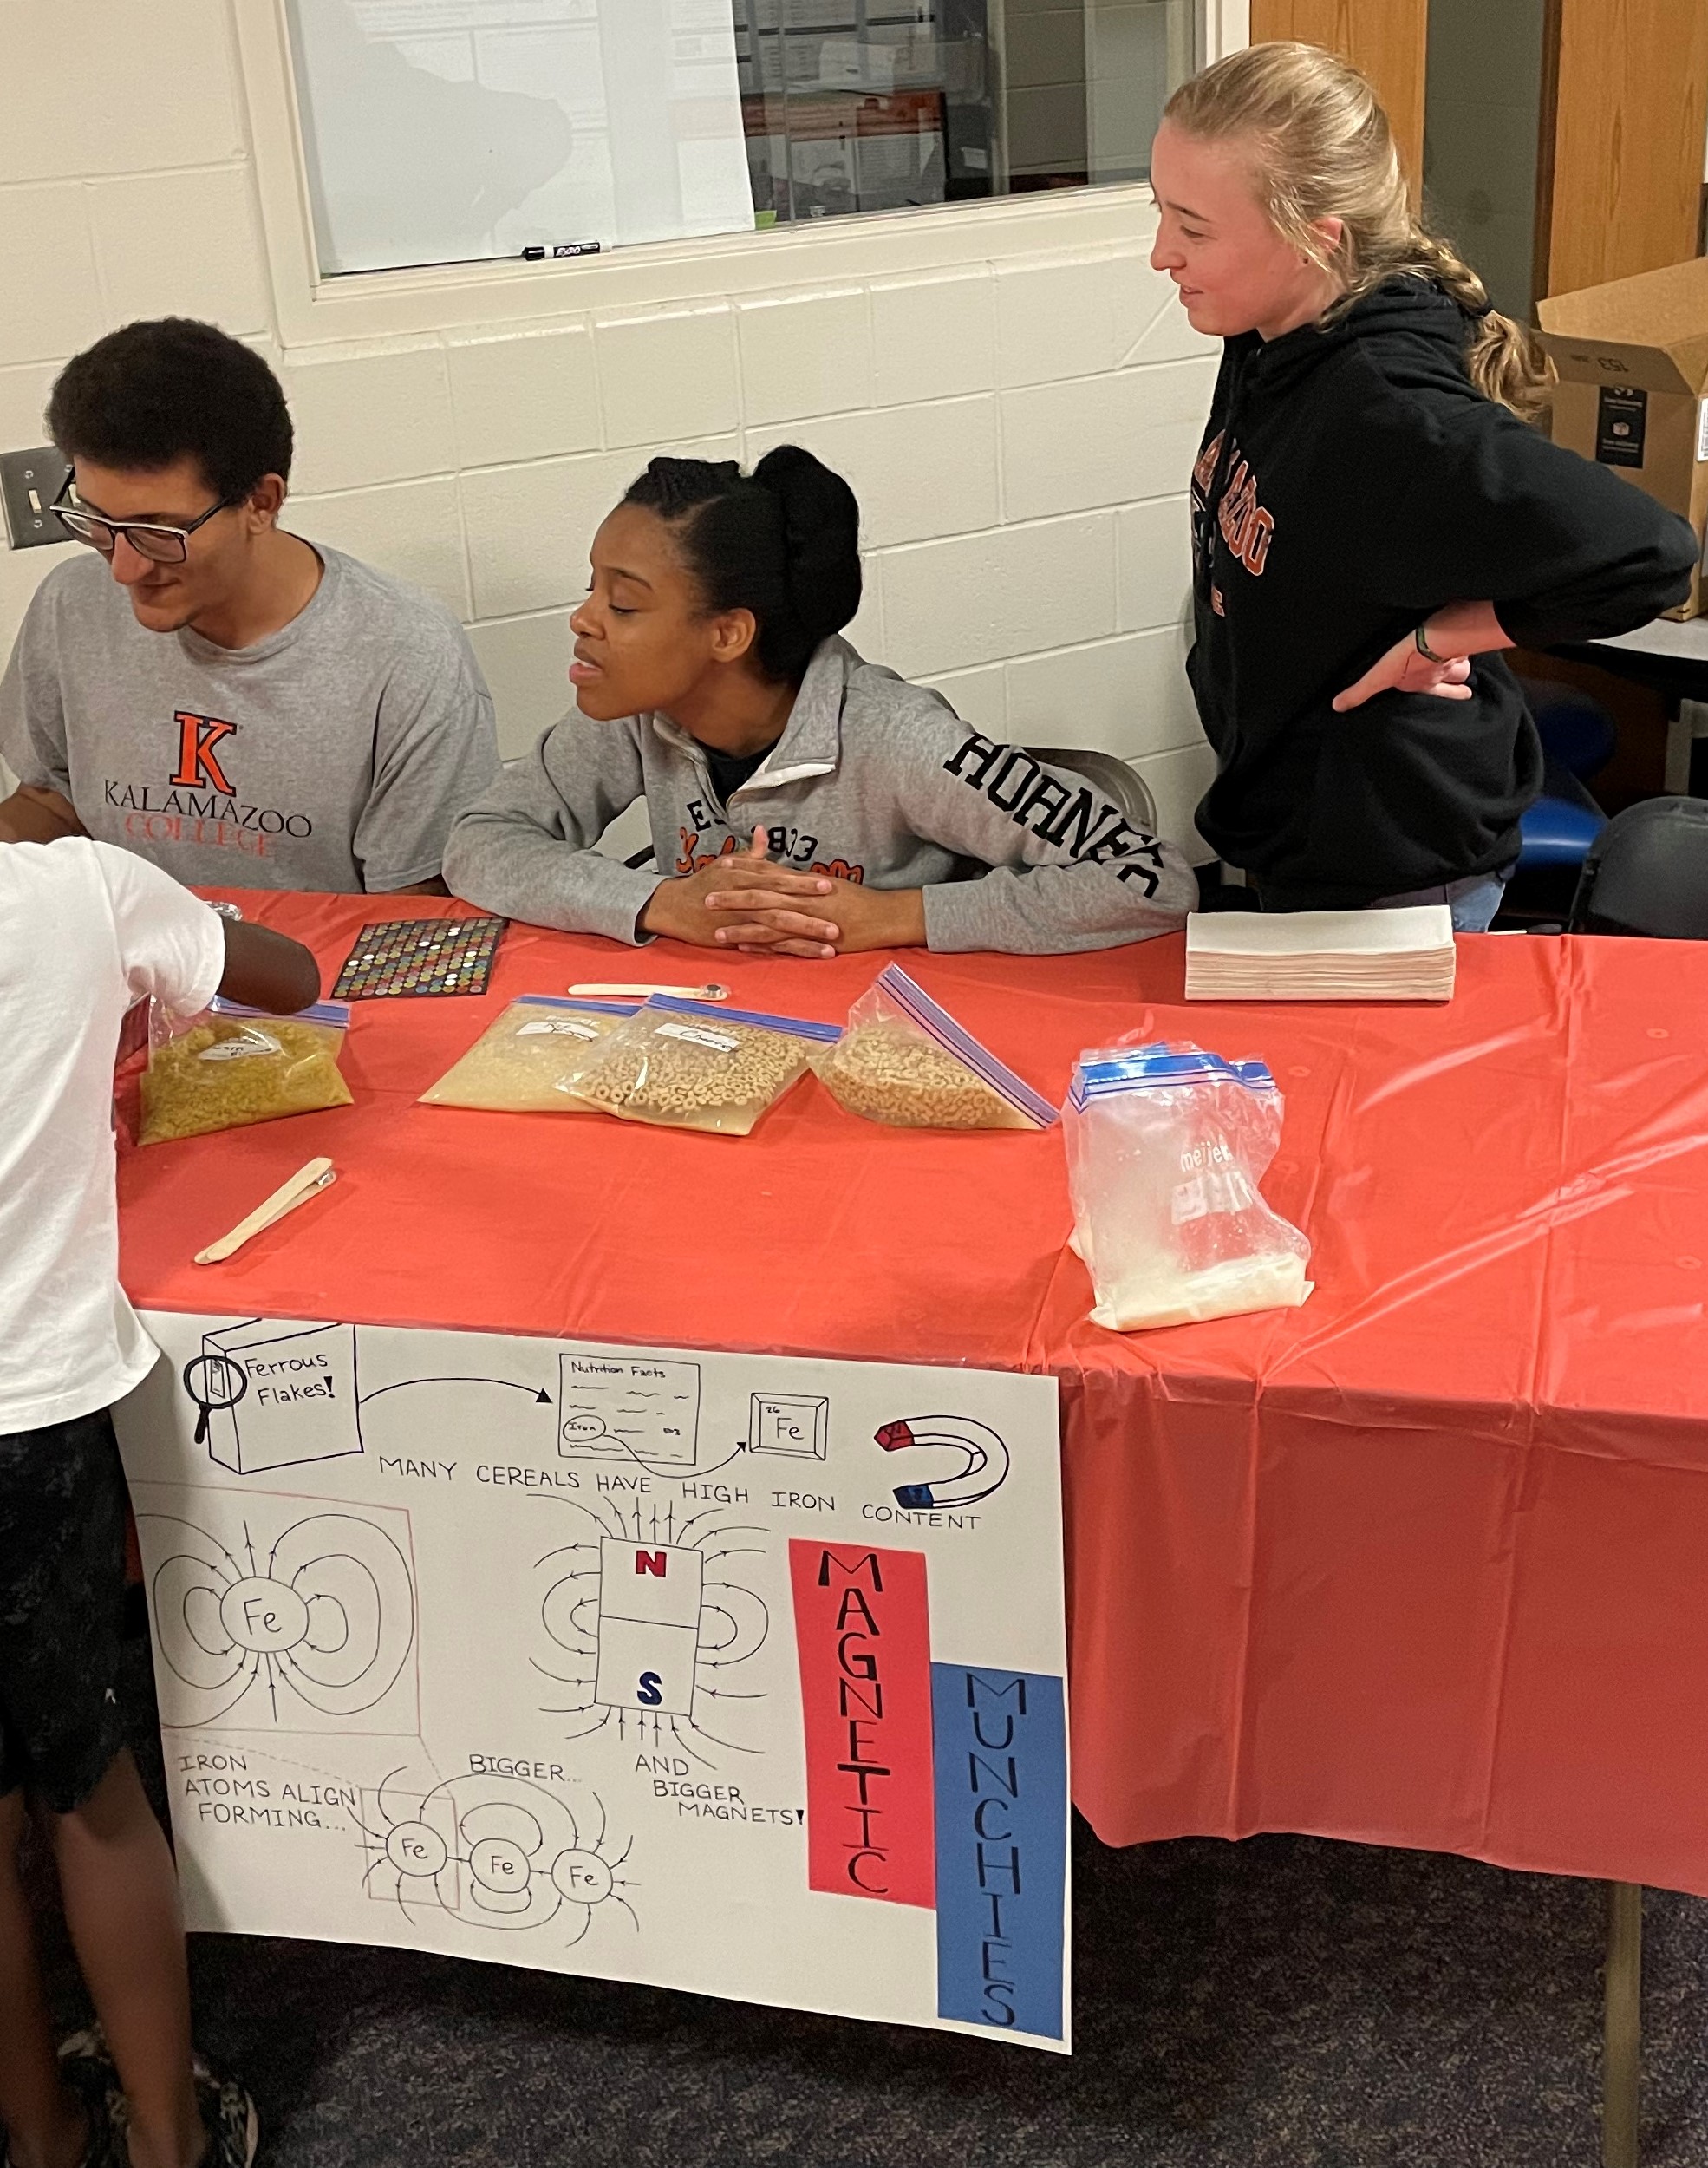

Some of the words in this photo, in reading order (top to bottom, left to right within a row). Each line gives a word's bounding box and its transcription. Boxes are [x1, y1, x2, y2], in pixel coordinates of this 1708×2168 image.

[169, 710, 238, 798] K
[104, 779, 313, 839] KALAMAZOO
[942, 732, 1164, 899] HORNE
[1180, 1140, 1235, 1172] meijer
[244, 1354, 329, 1379] Ferrous
[571, 1361, 624, 1375] Nutrition
[631, 1366, 666, 1378] Facts
[258, 1375, 336, 1406] Flakes!
[568, 1422, 596, 1432] Iron
[777, 1417, 805, 1440] Fe
[379, 1456, 457, 1480] MANY
[476, 1465, 581, 1489] CEREALS
[596, 1473, 652, 1493] HAVE
[682, 1482, 749, 1504] HIGH
[772, 1492, 835, 1511] IRON
[862, 1504, 982, 1530] CONTENT
[635, 1550, 667, 1578] N
[243, 1597, 283, 1636] Fe
[636, 1671, 662, 1706] S
[818, 1550, 891, 1894] MAGNETIC
[178, 1754, 247, 1772] IRON
[635, 1754, 690, 1776] AND
[185, 1779, 271, 1798] ATOMS
[282, 1783, 356, 1806] ALIGN
[653, 1779, 745, 1805] BIGGER
[401, 1838, 429, 1859] Fe
[966, 1673, 1027, 2027] MUNCHIES
[491, 1856, 515, 1875] Fe
[570, 1866, 599, 1888] Fe
